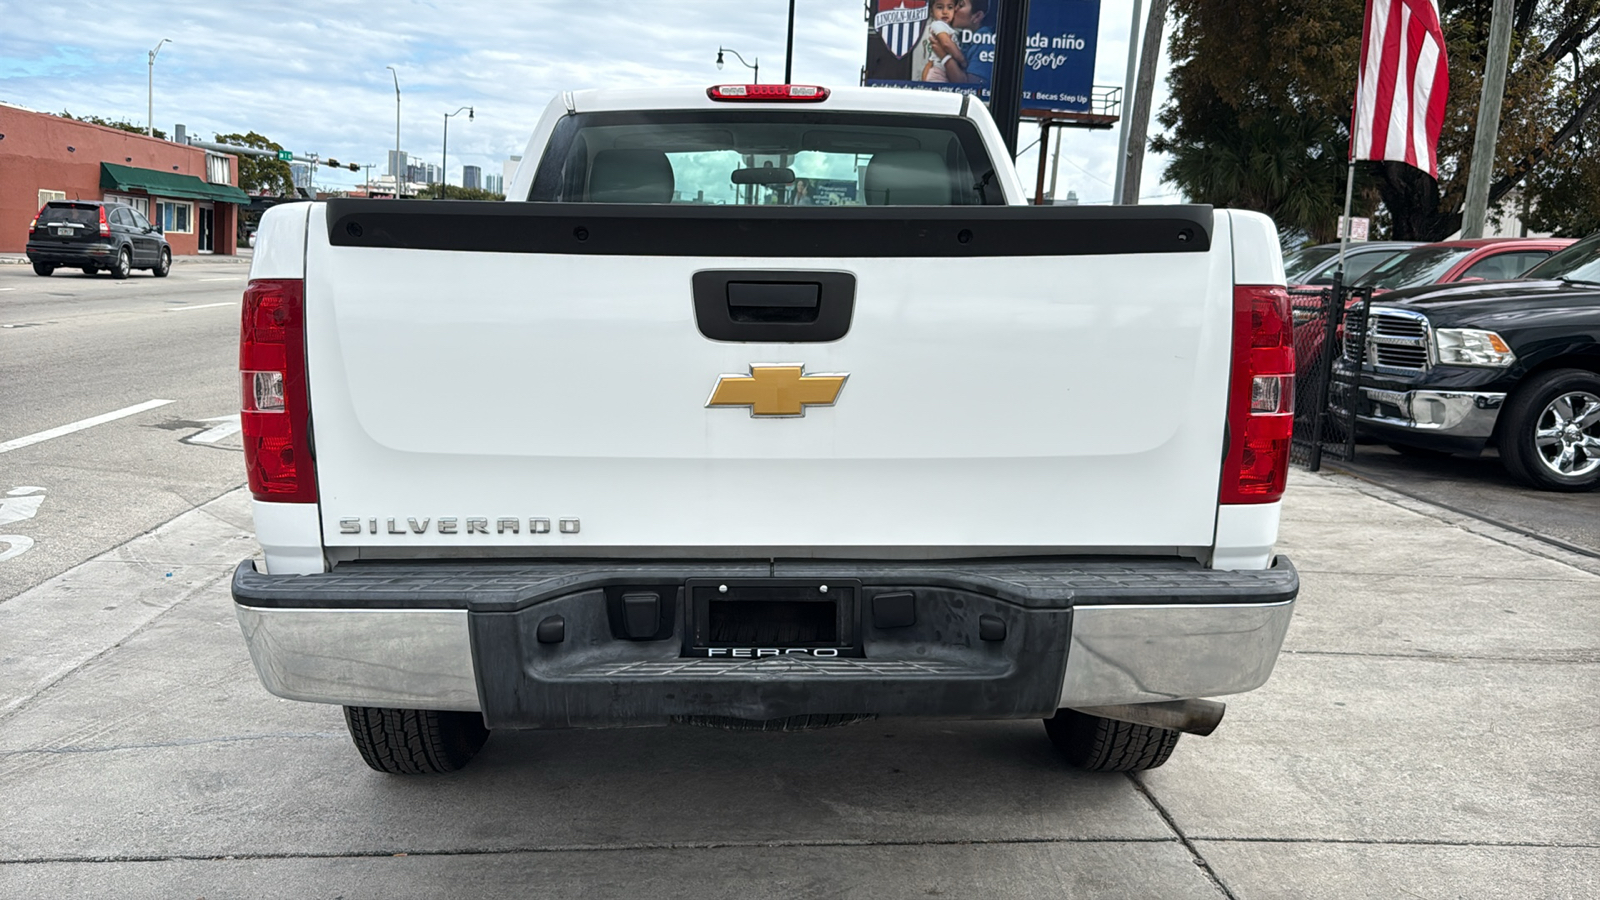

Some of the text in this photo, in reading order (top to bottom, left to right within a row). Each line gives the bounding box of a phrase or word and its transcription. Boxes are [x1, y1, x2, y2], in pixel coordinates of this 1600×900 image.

[876, 8, 927, 26] LINCOLN-MARTI
[1052, 33, 1085, 50] niño
[1024, 48, 1068, 70] Tesoro
[955, 87, 977, 96] Gratis
[1036, 91, 1058, 101] Becas
[1059, 93, 1076, 104] Step
[1077, 95, 1088, 105] Up
[339, 517, 581, 535] SILVERADO
